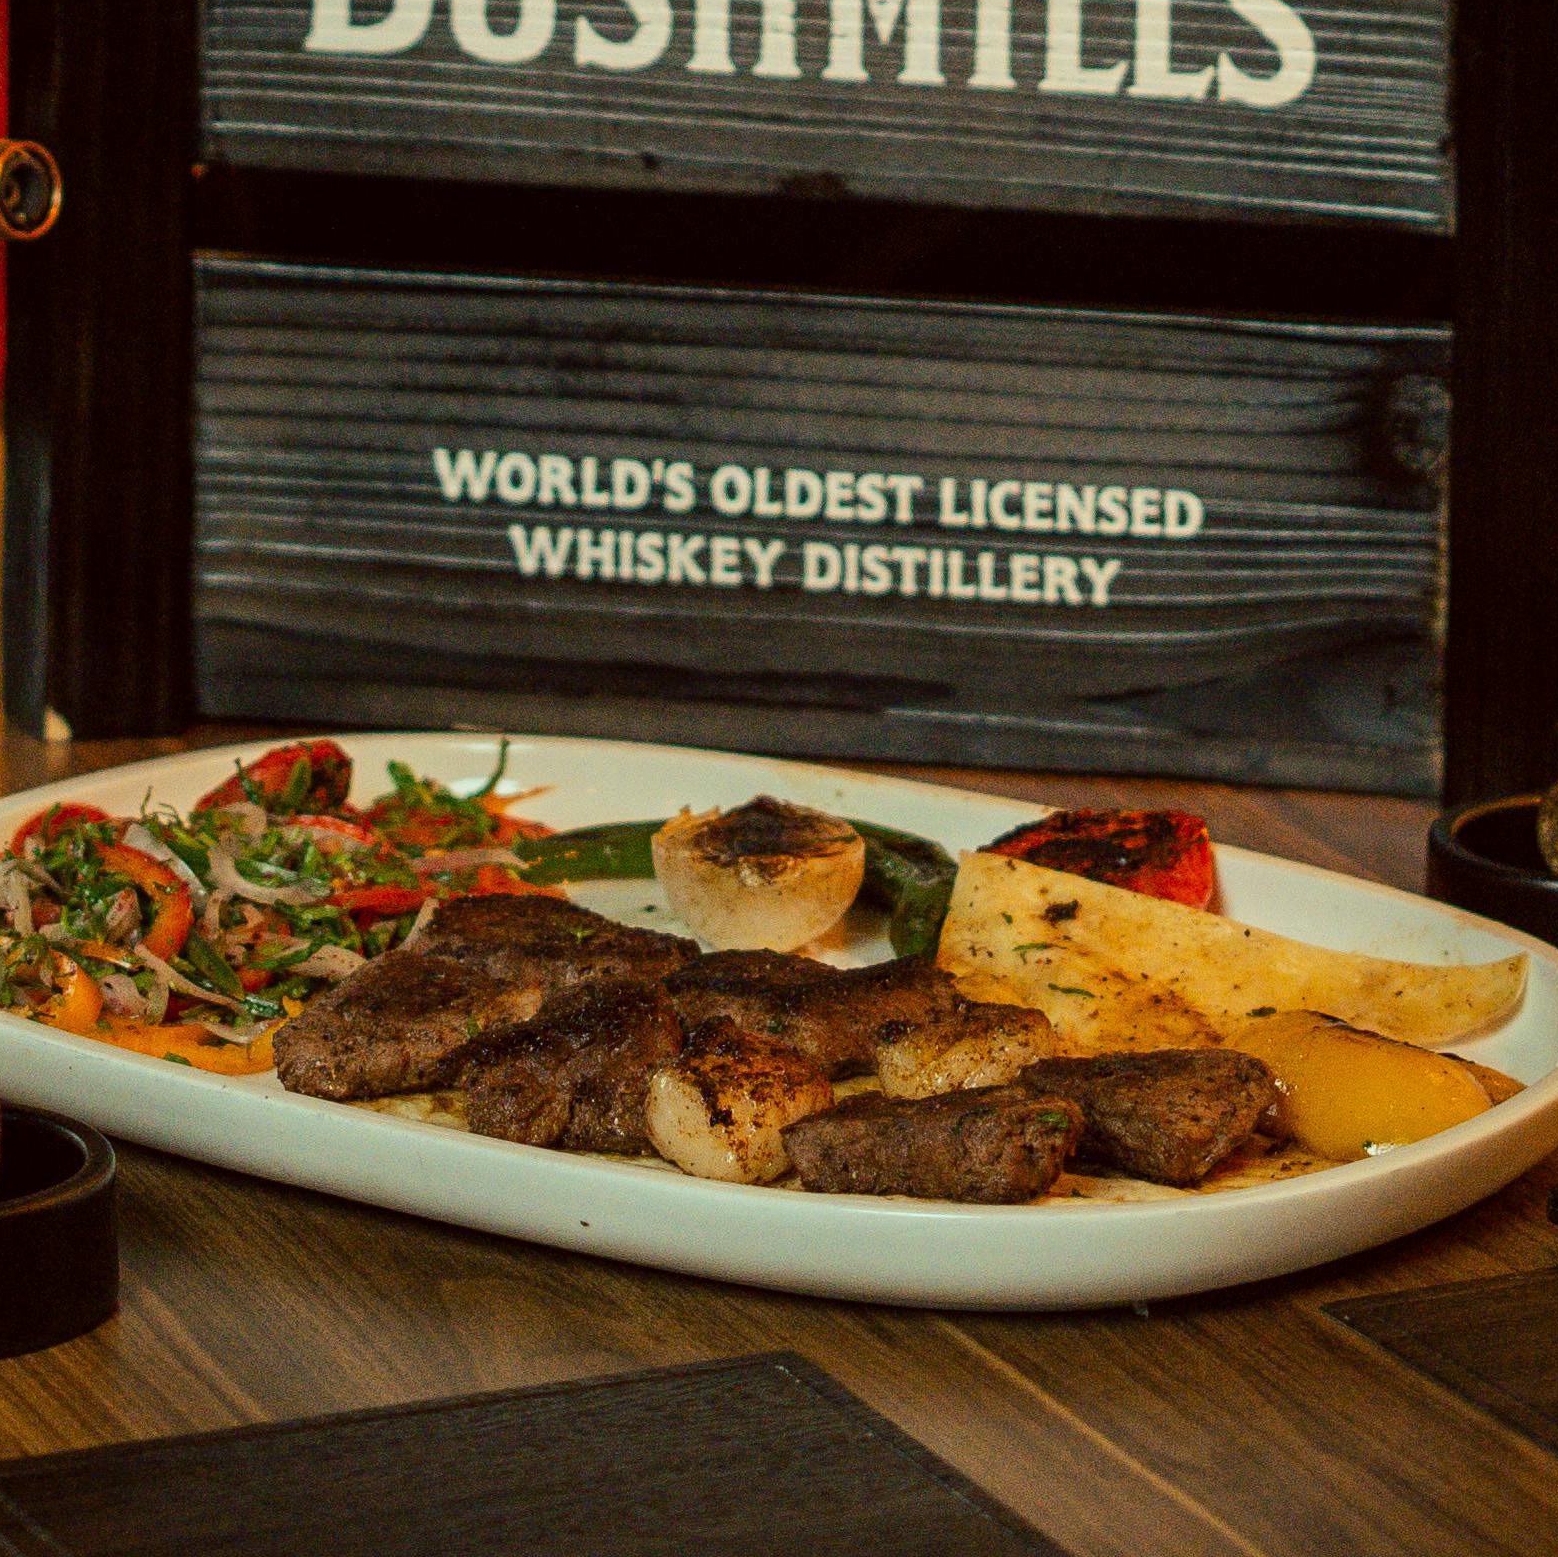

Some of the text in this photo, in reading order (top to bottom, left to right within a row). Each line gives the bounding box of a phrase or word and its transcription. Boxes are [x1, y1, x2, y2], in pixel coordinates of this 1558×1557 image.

[432, 447, 1205, 540] WORLD'S OLDEST LICENSED
[507, 524, 1122, 607] WHISKEY DISTILLERY
